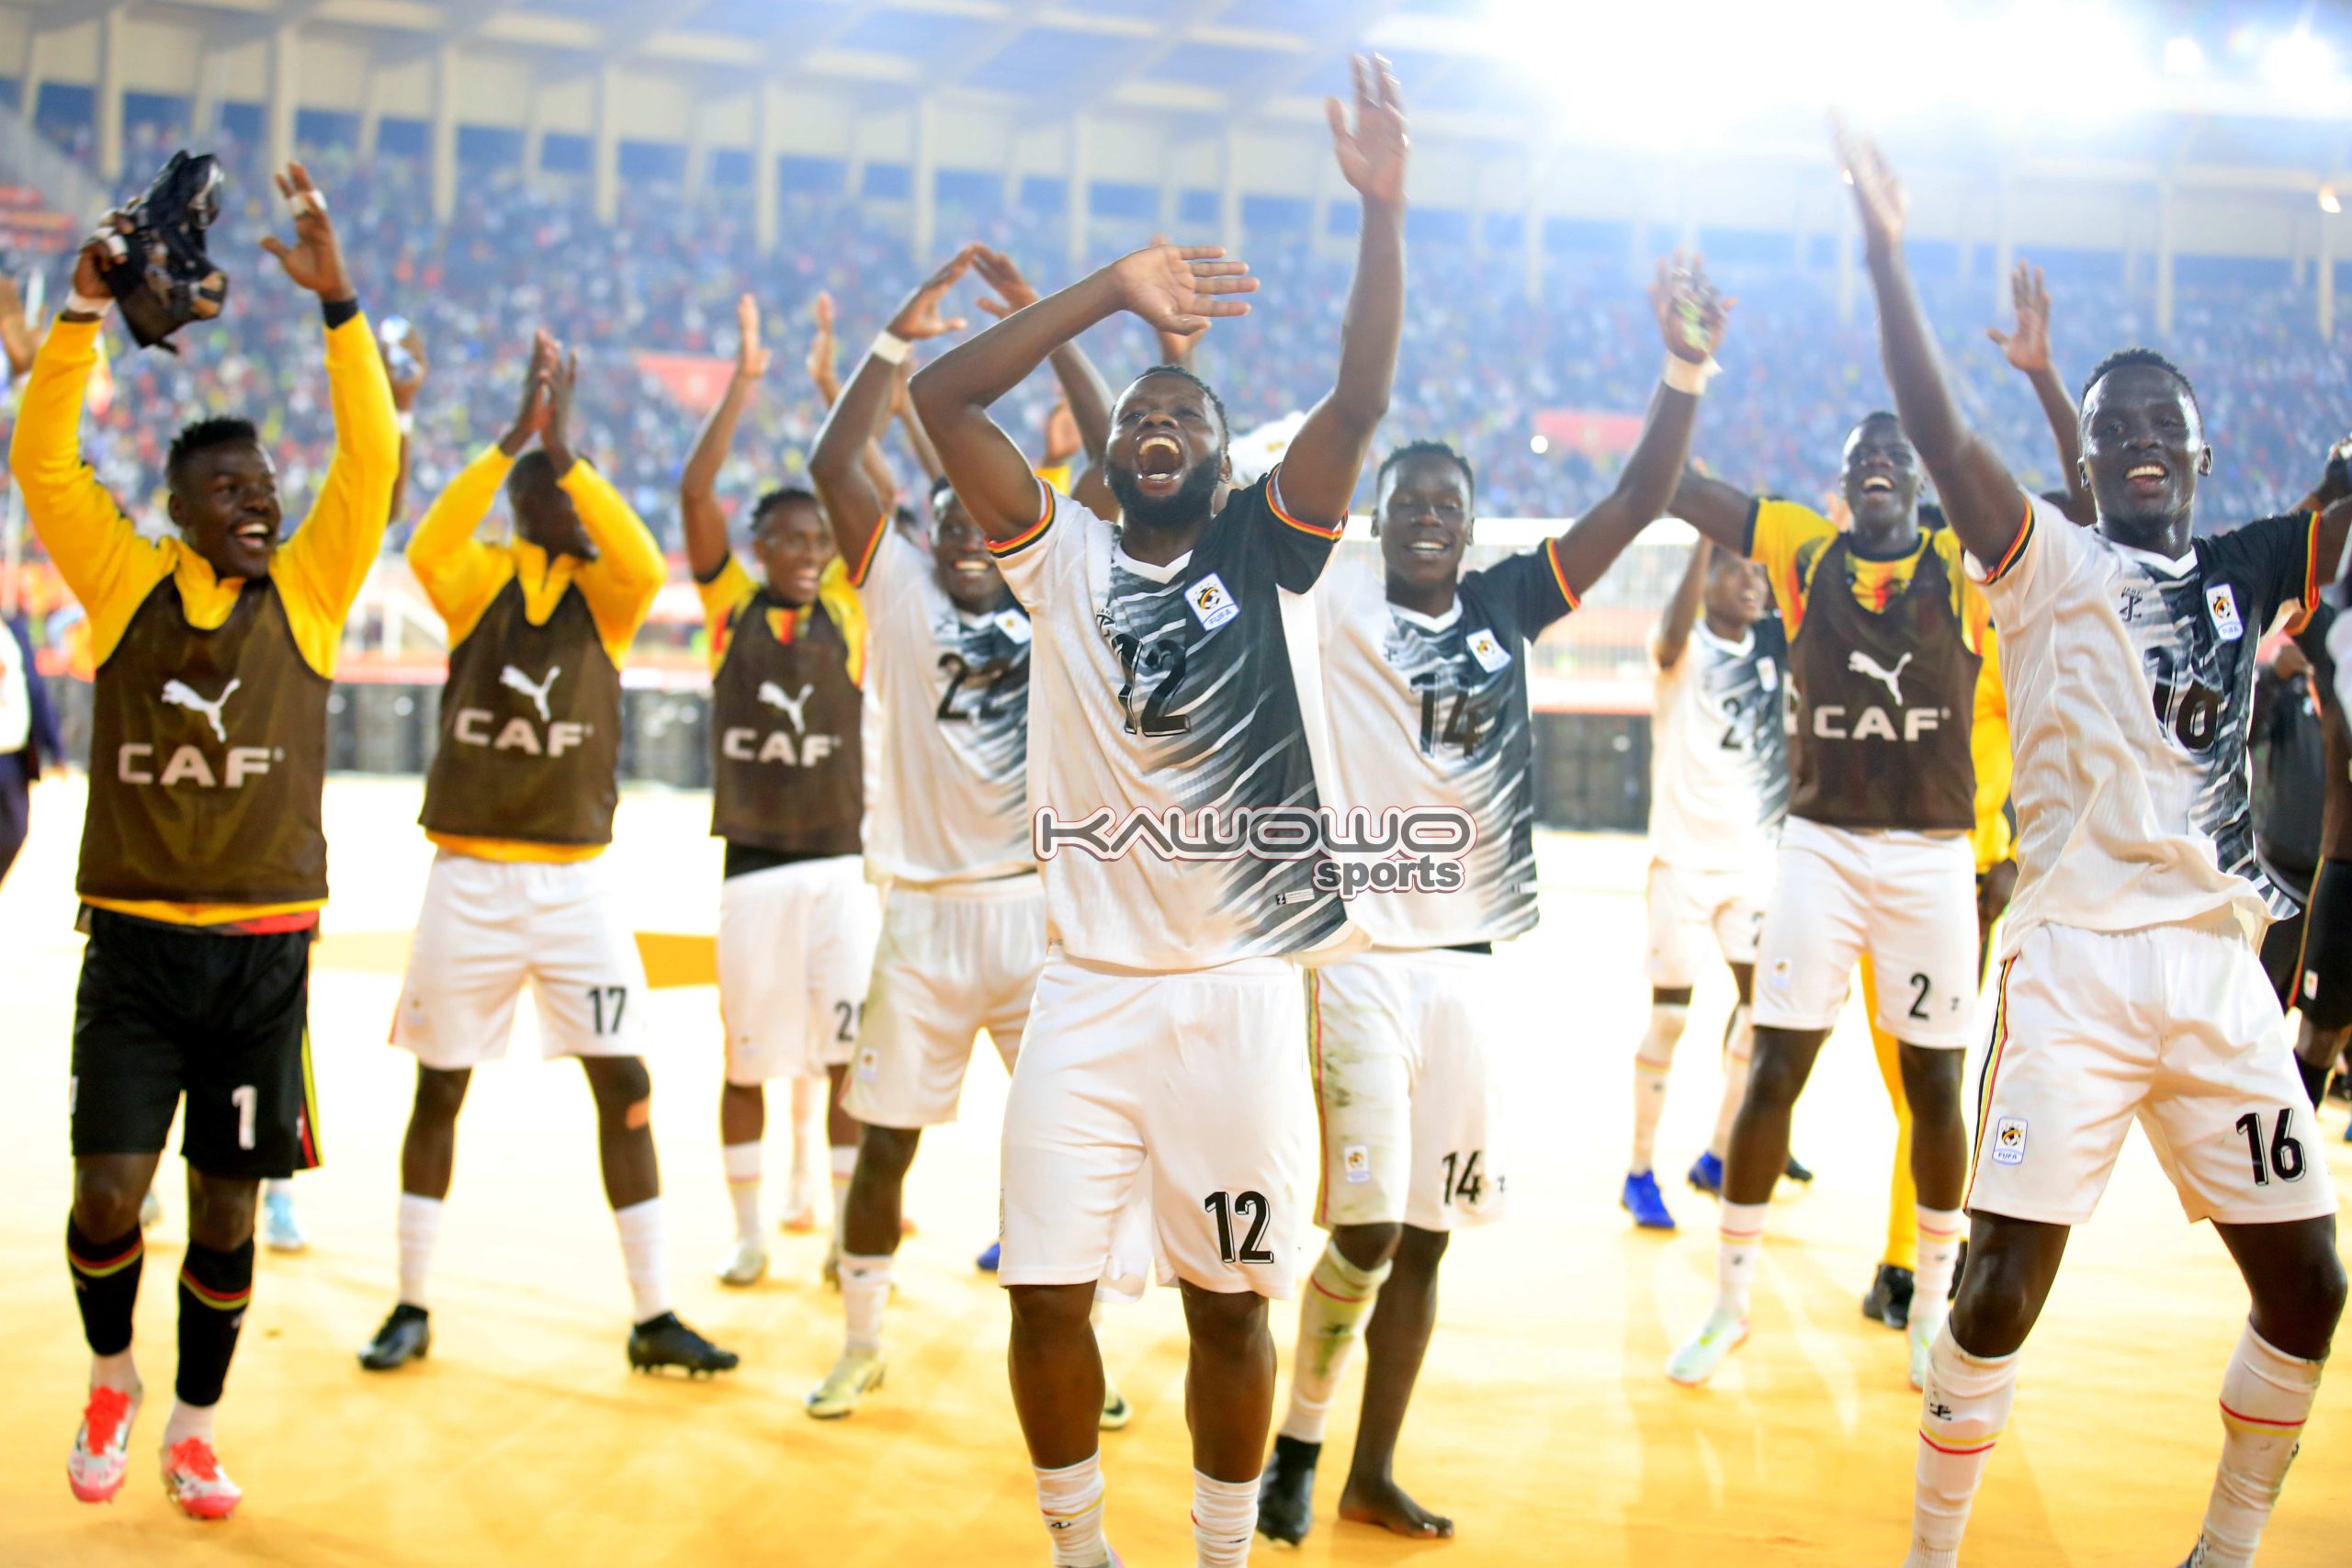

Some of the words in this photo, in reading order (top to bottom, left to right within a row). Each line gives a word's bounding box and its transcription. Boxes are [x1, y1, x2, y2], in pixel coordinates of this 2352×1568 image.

[1209, 609, 1232, 625] FUFA
[937, 651, 1011, 721] 22
[1112, 633, 1191, 737] 12
[2143, 646, 2220, 753] 16
[455, 708, 583, 758] CAF
[1410, 672, 1485, 761] 14
[1814, 705, 1939, 741] CAF
[119, 743, 270, 788] CAF
[722, 727, 832, 768] CAF
[587, 987, 627, 1034] 17
[835, 1000, 865, 1041] 2
[1909, 972, 1931, 1020] 2
[232, 1085, 256, 1150] 1
[2235, 1108, 2307, 1186] 16
[1442, 1150, 1482, 1205] 14
[1204, 1190, 1274, 1264] 12
